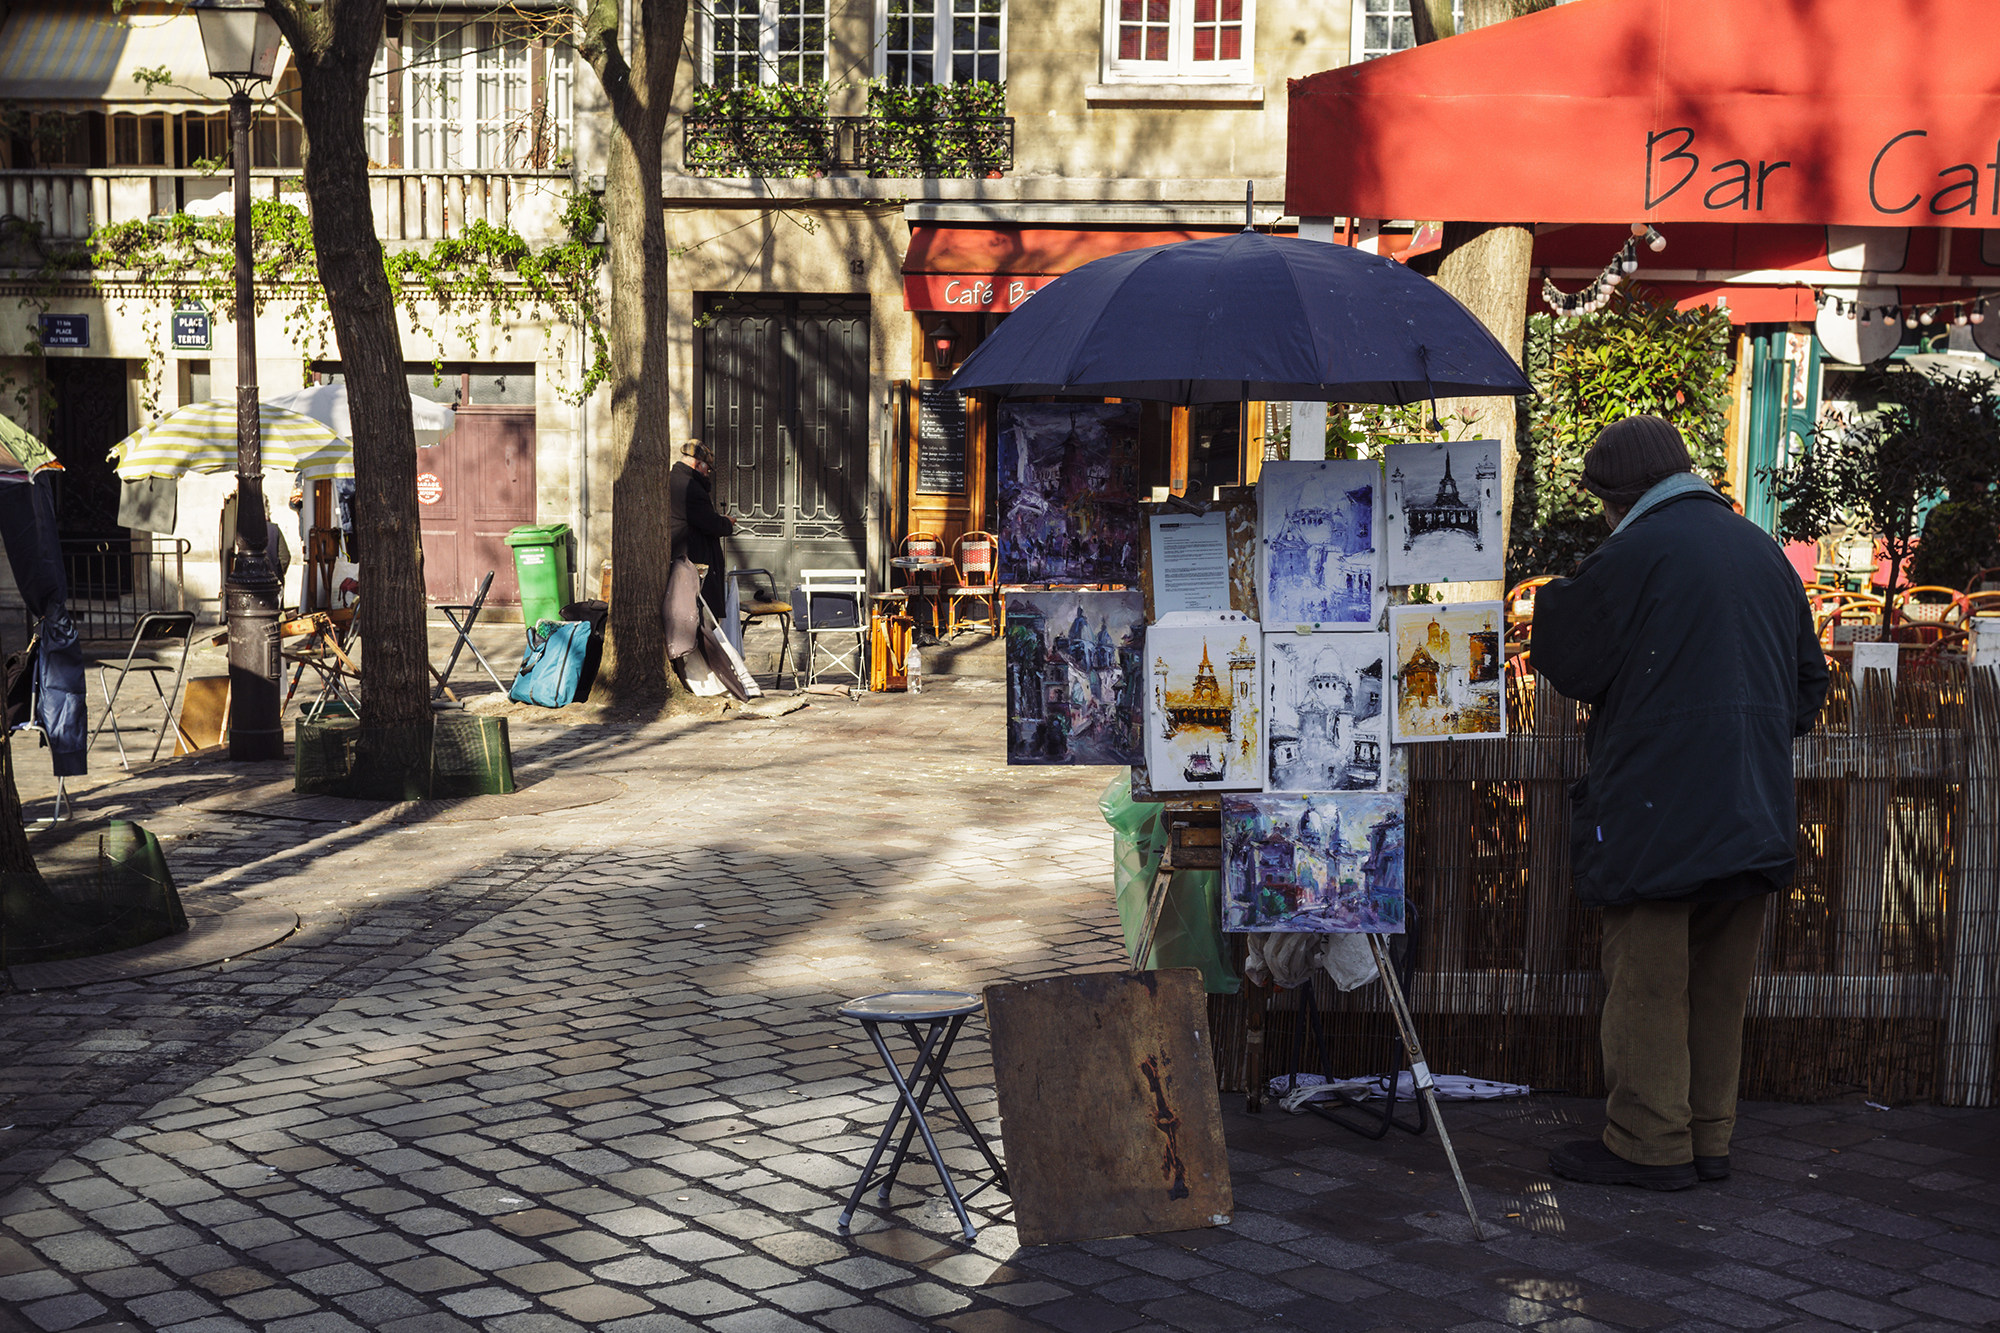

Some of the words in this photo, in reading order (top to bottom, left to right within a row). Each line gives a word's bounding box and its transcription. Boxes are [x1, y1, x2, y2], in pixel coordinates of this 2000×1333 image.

[1645, 127, 1791, 211] Bar
[850, 260, 865, 275] 13
[944, 280, 994, 305] Café
[179, 317, 204, 327] PLACE
[50, 336, 58, 344] DU
[59, 336, 79, 344] TERTRE
[177, 335, 206, 345] TERTRE
